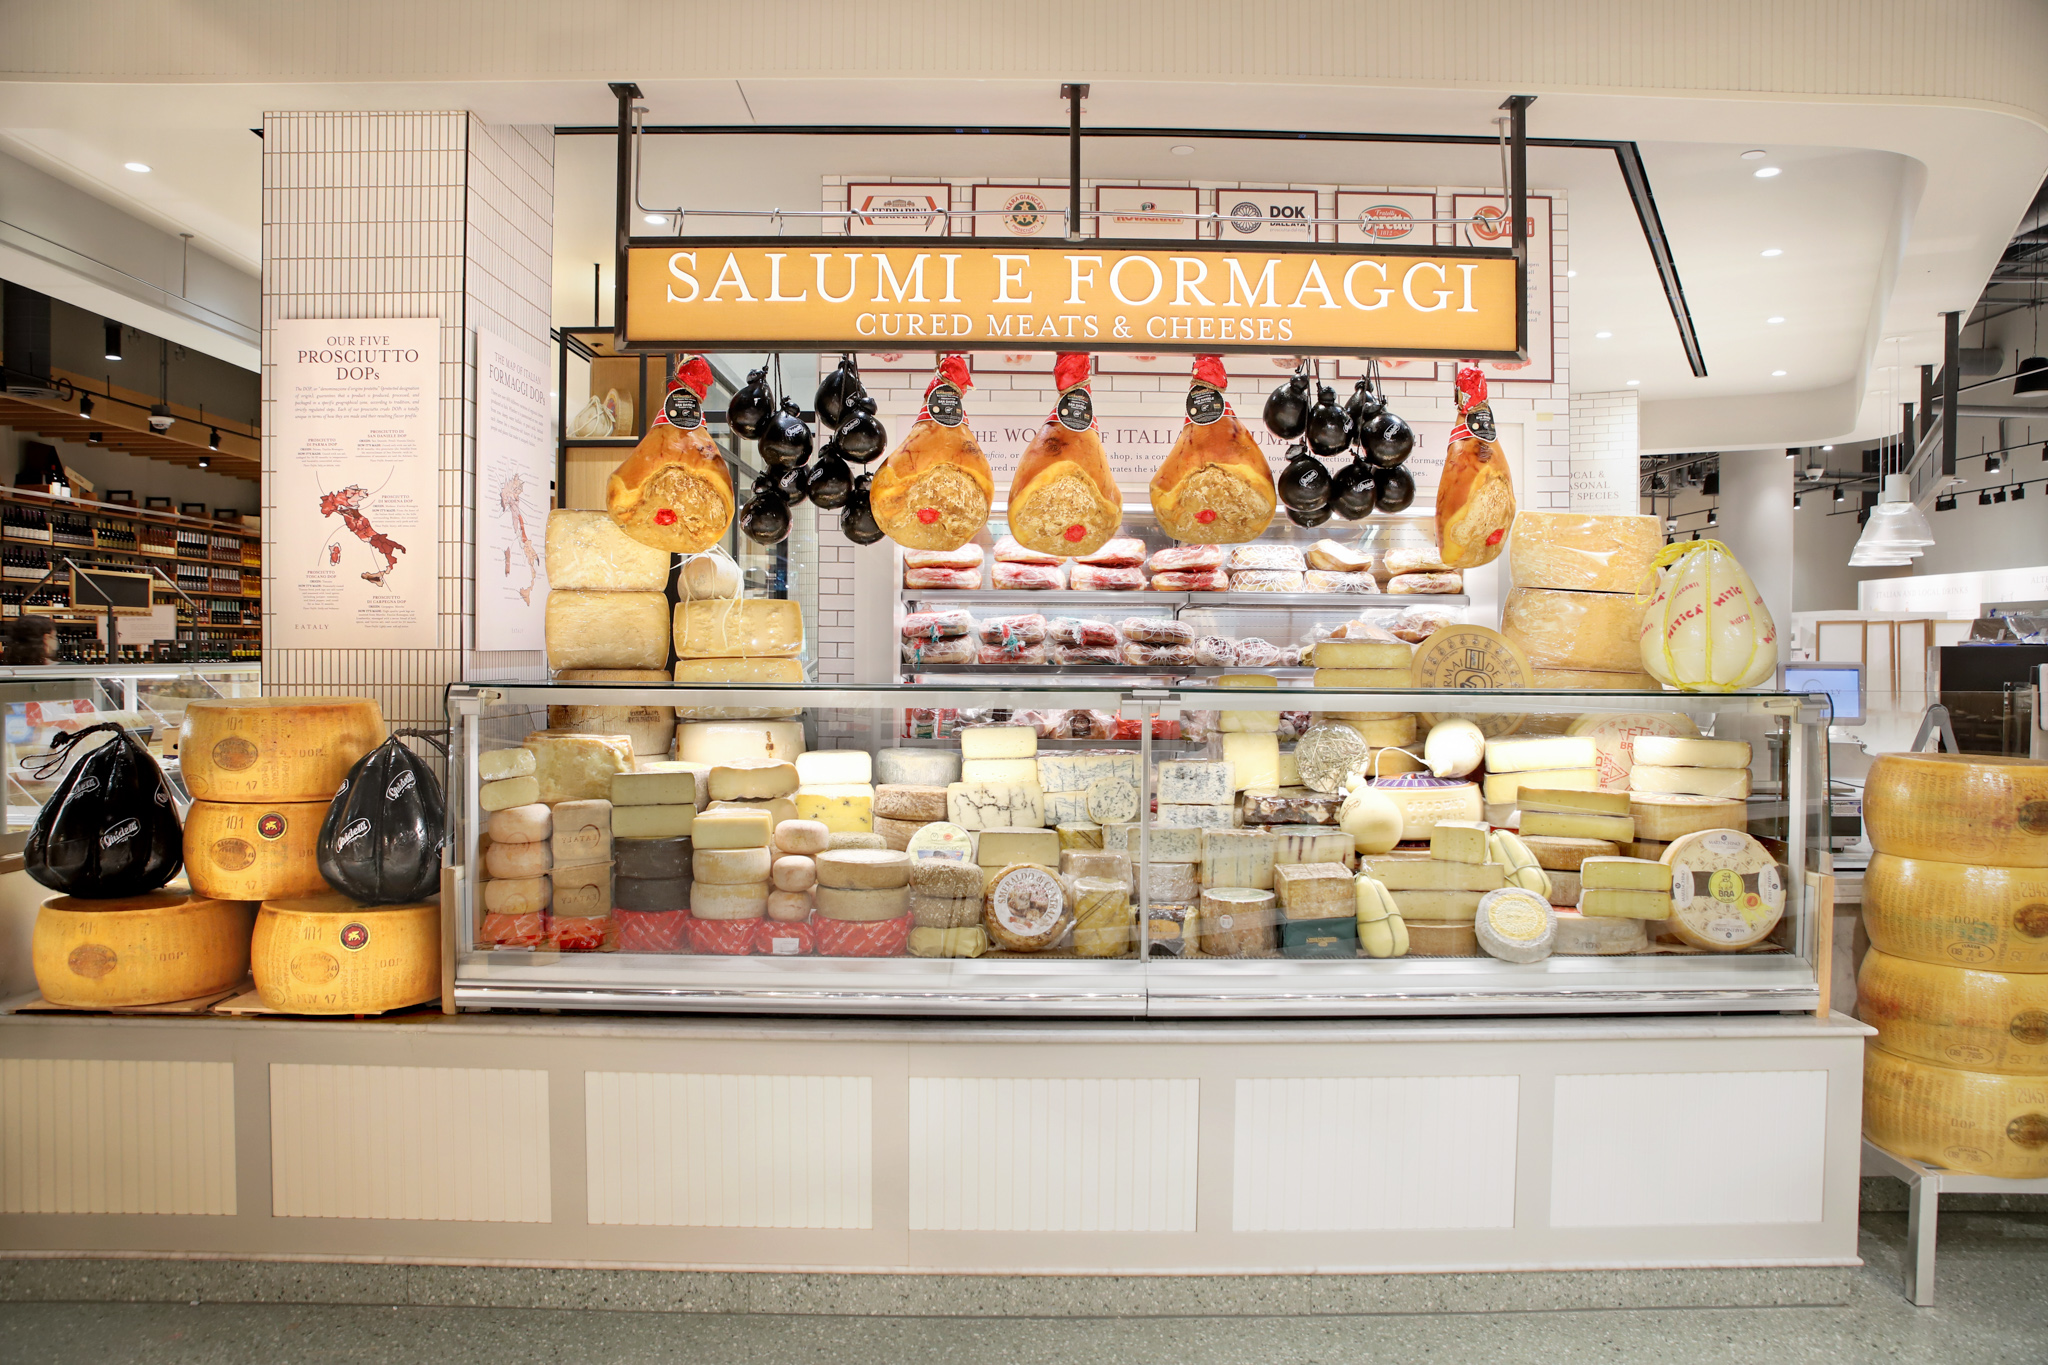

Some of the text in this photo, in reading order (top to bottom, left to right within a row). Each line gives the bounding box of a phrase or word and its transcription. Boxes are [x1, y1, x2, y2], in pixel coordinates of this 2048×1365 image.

[1270, 206, 1305, 218] DOK
[666, 251, 1479, 314] SALUMI E FORMAGGI
[856, 312, 1294, 342] CURED MEATS & CHEESES
[327, 335, 390, 346] OUR FIVE
[297, 349, 419, 363] PROSCIUTTO
[337, 366, 380, 380] DOPs
[494, 351, 542, 385] THE MAP OF ITALIAN
[489, 364, 546, 406] FORMAGGI DOPs
[974, 431, 997, 443] HE
[1136, 452, 1143, 460] is
[990, 464, 1007, 472] ured
[1577, 491, 1619, 500] SPECIES
[1942, 586, 1969, 596] DRINKS
[1443, 658, 1463, 688] RMAI
[226, 716, 243, 731] 101
[225, 815, 244, 830] 101
[998, 872, 1058, 922] SMERALDO di CENTRAL
[325, 994, 336, 1004] 17
